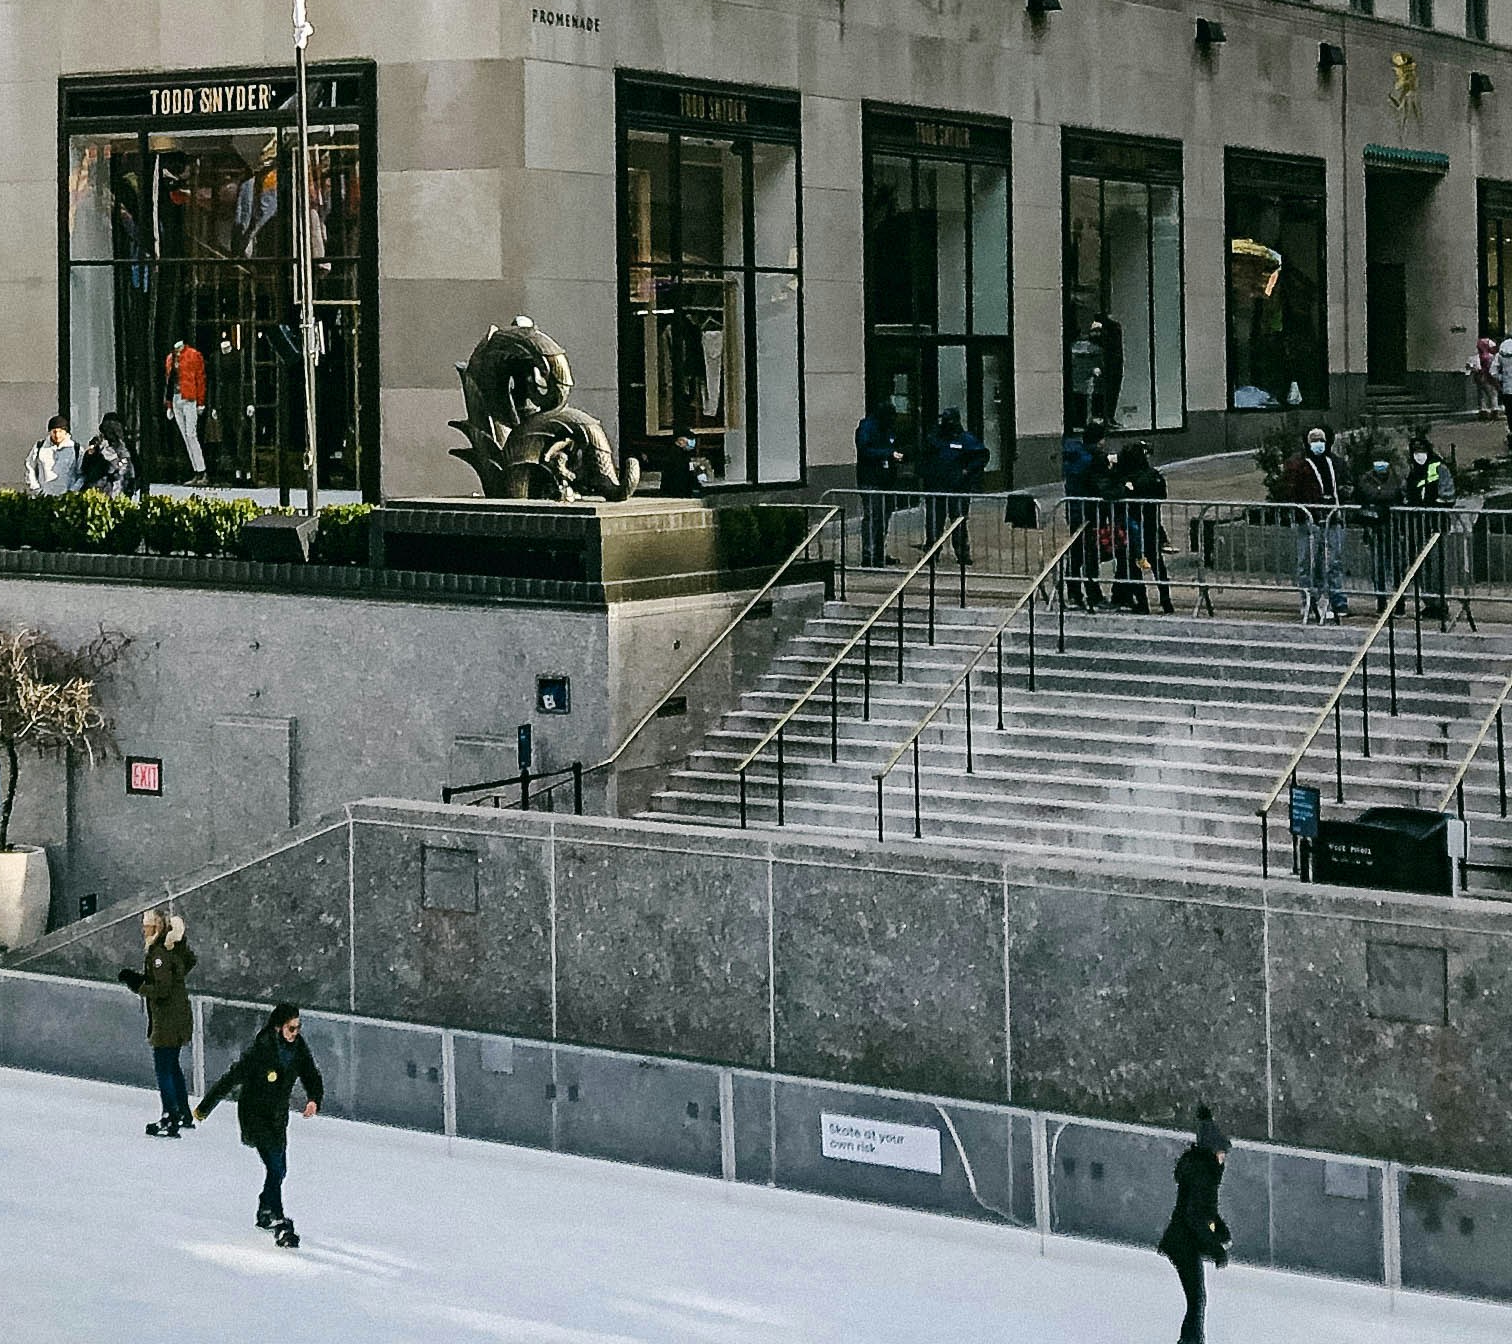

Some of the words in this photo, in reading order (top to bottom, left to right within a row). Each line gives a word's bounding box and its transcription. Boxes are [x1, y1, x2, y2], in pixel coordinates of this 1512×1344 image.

[532, 8, 600, 32] PROMENADE
[149, 88, 194, 115] TODD
[199, 84, 270, 113] SNYDER
[133, 765, 157, 789] EXIT
[829, 1123, 861, 1139] Skate
[863, 1130, 876, 1141] at
[878, 1133, 905, 1144] your
